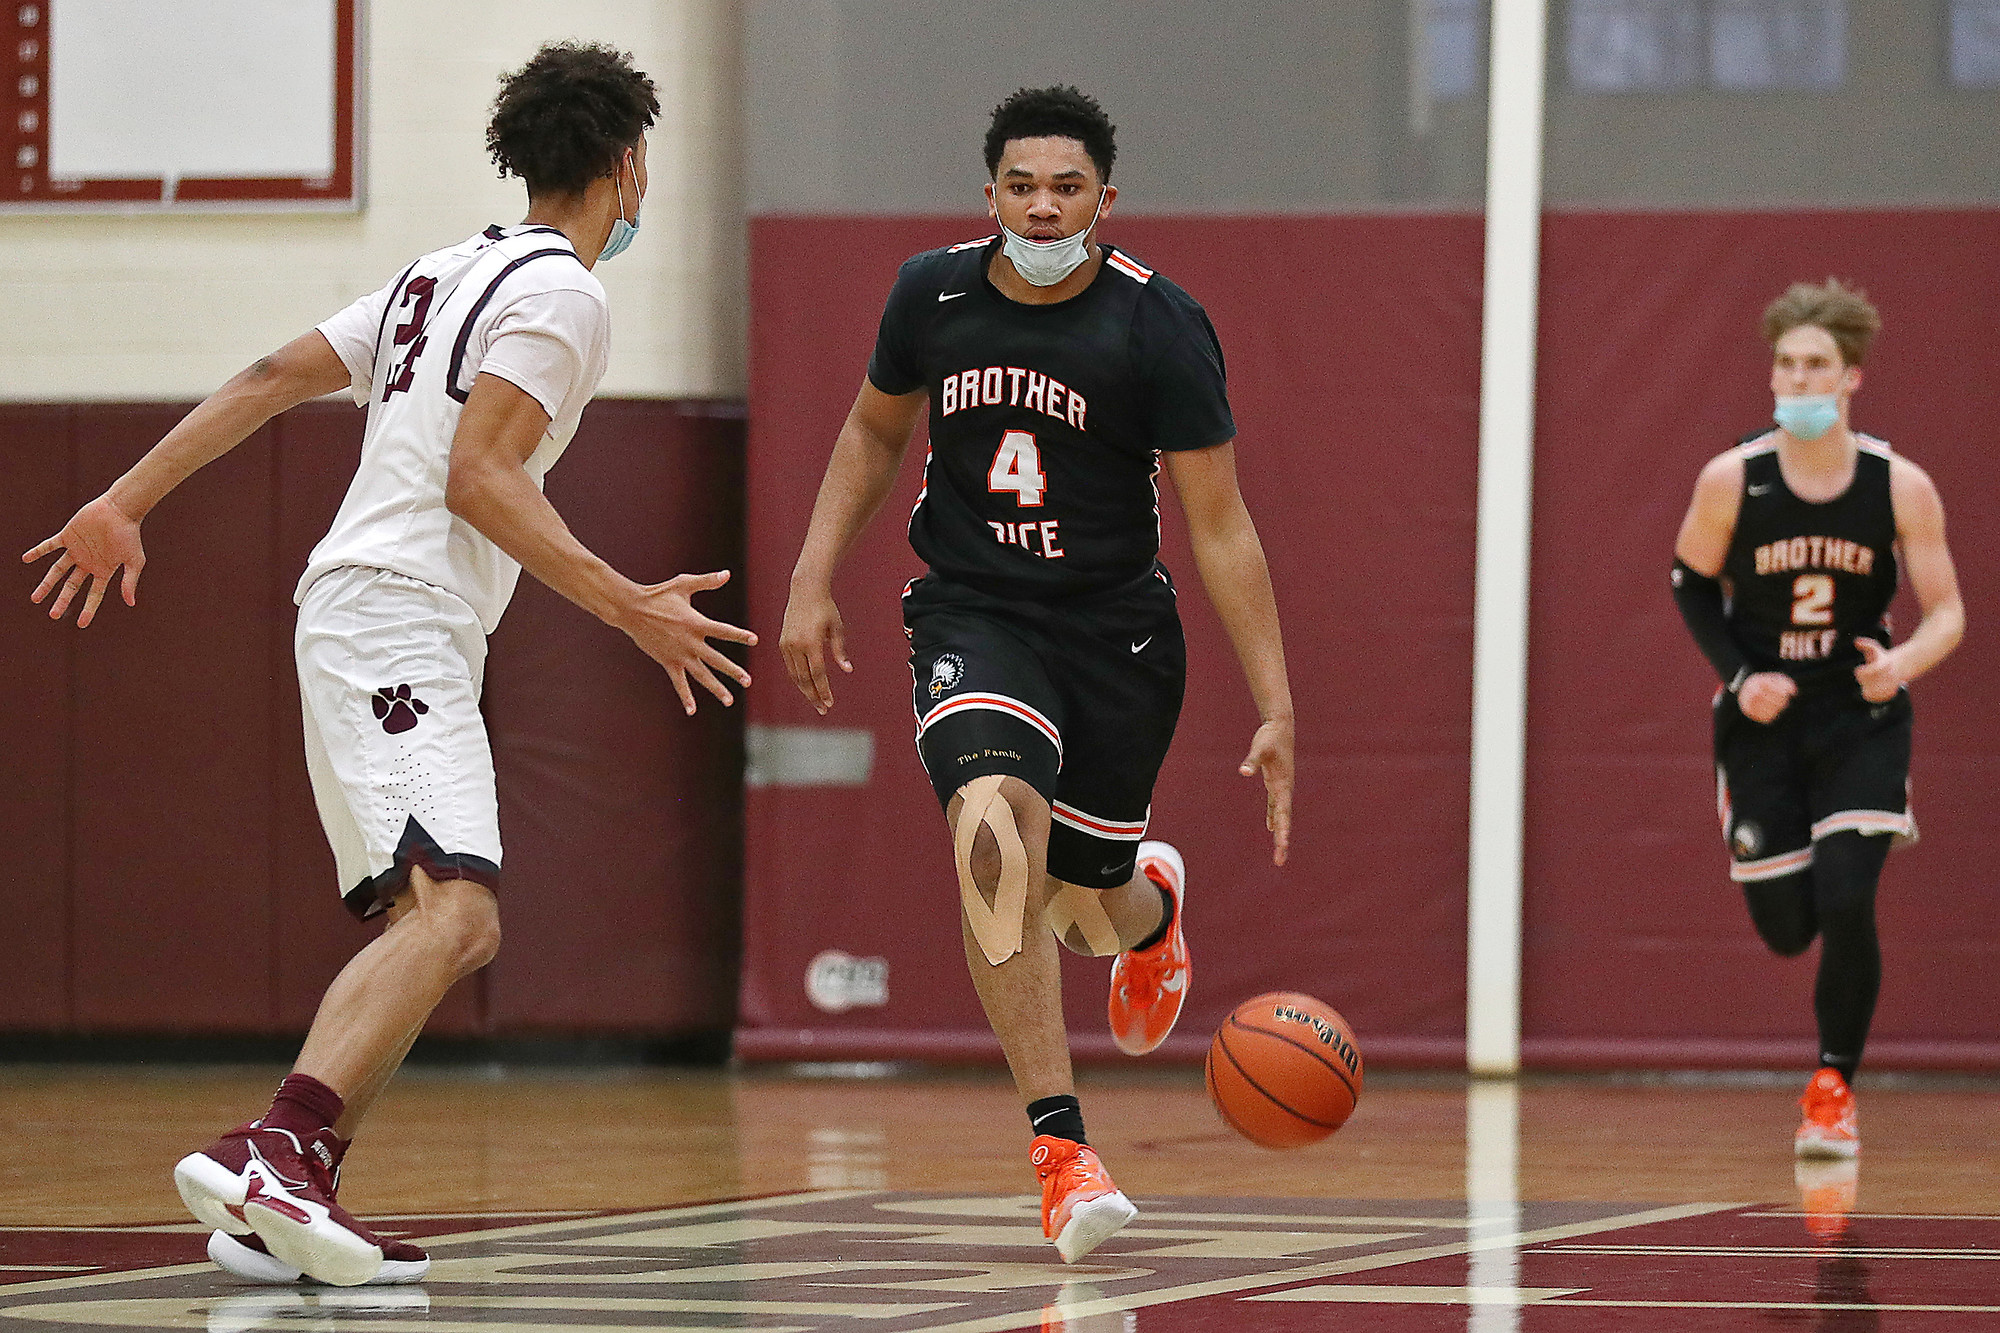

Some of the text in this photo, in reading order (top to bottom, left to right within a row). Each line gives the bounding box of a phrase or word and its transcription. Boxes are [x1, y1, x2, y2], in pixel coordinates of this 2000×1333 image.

[942, 366, 1087, 431] BROTHER
[987, 429, 1047, 508] 4
[1755, 536, 1875, 576] BROTHER
[1790, 573, 1837, 626] 2
[957, 752, 978, 766] The
